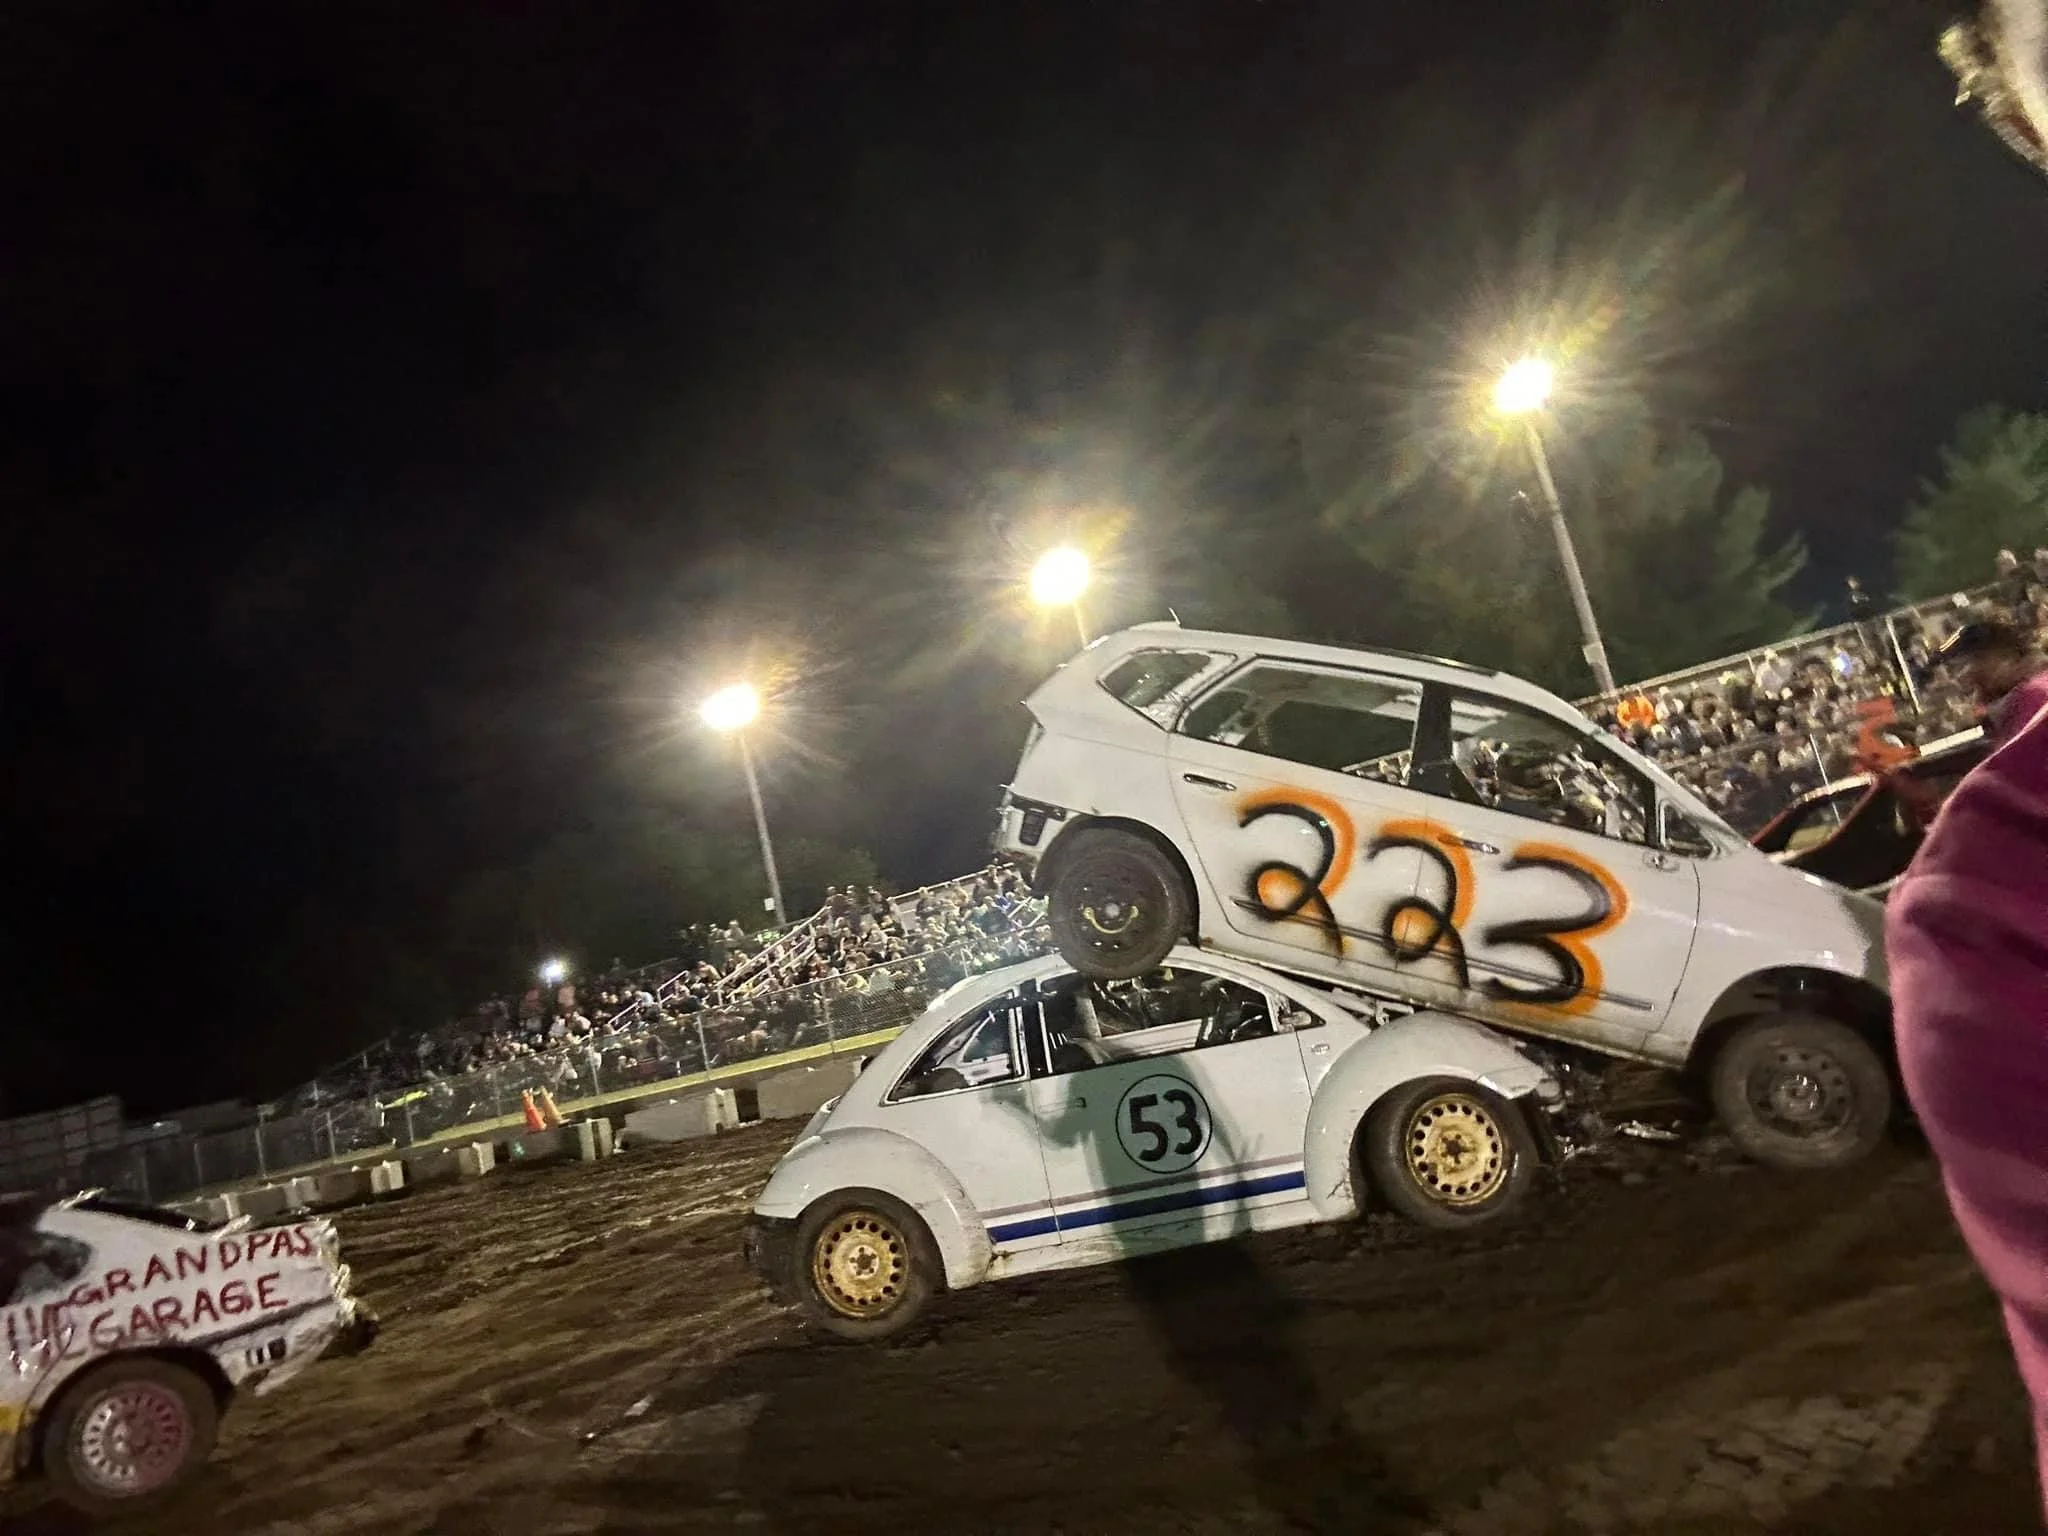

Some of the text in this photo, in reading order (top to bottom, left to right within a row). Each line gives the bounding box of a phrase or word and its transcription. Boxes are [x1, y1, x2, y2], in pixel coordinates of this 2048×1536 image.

[1237, 788, 1627, 1015] 223
[1129, 1088, 1200, 1162] 53
[67, 1226, 315, 1306] GRANDPAS
[88, 1271, 289, 1349] GARAGE
